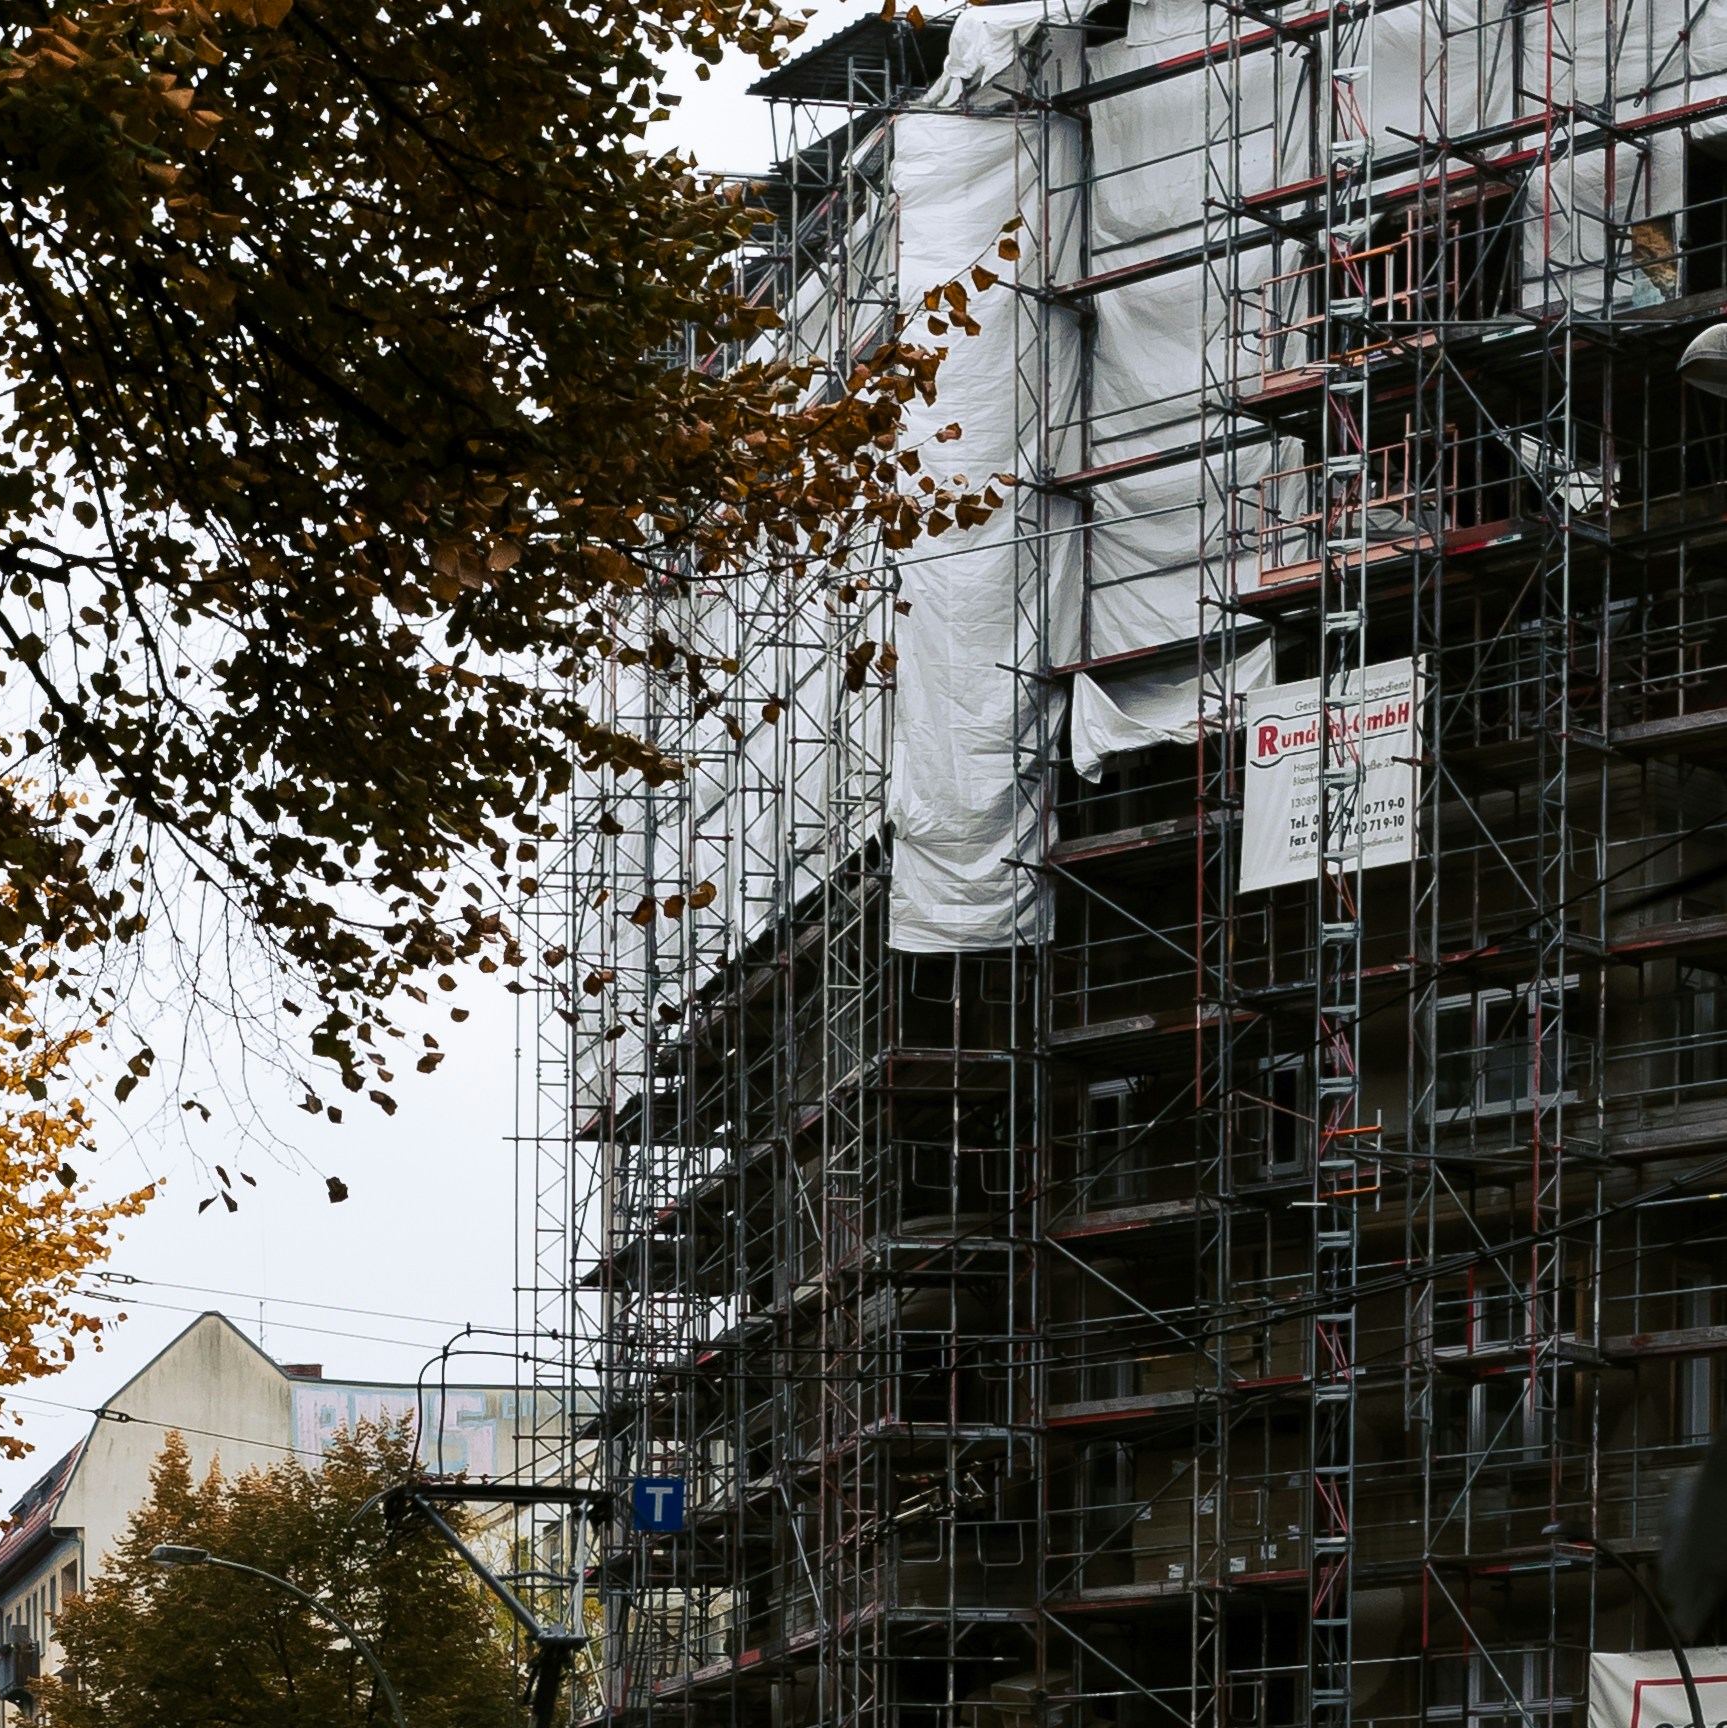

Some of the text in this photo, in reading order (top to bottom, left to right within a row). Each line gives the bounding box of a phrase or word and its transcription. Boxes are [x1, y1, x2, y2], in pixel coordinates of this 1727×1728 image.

[1290, 814, 1308, 830] Tel.
[1289, 835, 1306, 847] Fax
[646, 1487, 673, 1522] T
